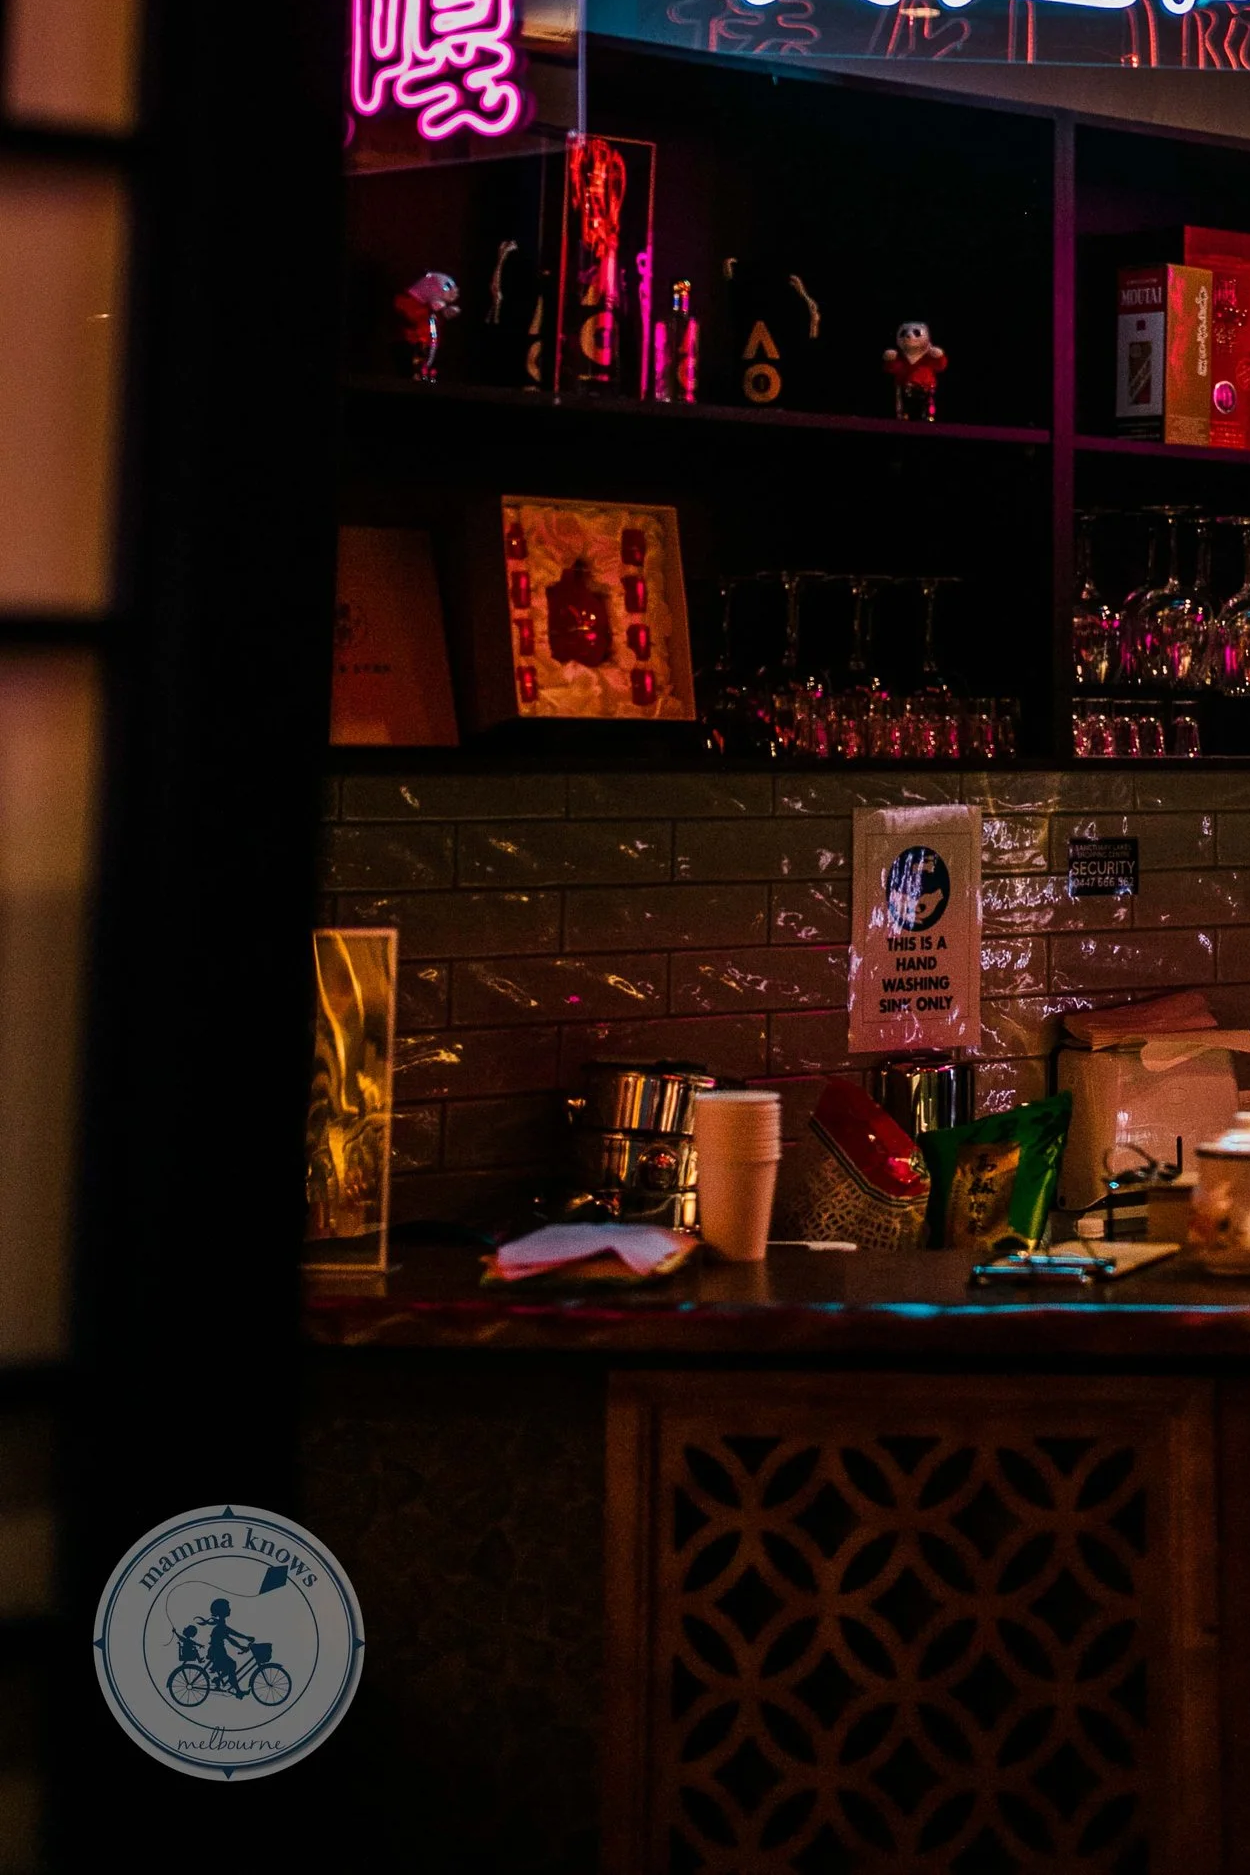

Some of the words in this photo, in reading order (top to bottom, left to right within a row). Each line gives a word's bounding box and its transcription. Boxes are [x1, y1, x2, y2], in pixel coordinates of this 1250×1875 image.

[1072, 860, 1136, 876] SECURITY
[887, 937, 918, 952] THIS
[920, 936, 933, 951] IS
[936, 936, 948, 950] A
[895, 956, 938, 971] HAND
[881, 975, 950, 992] WASHING
[879, 998, 912, 1014] SINK
[916, 995, 954, 1011] ONLY
